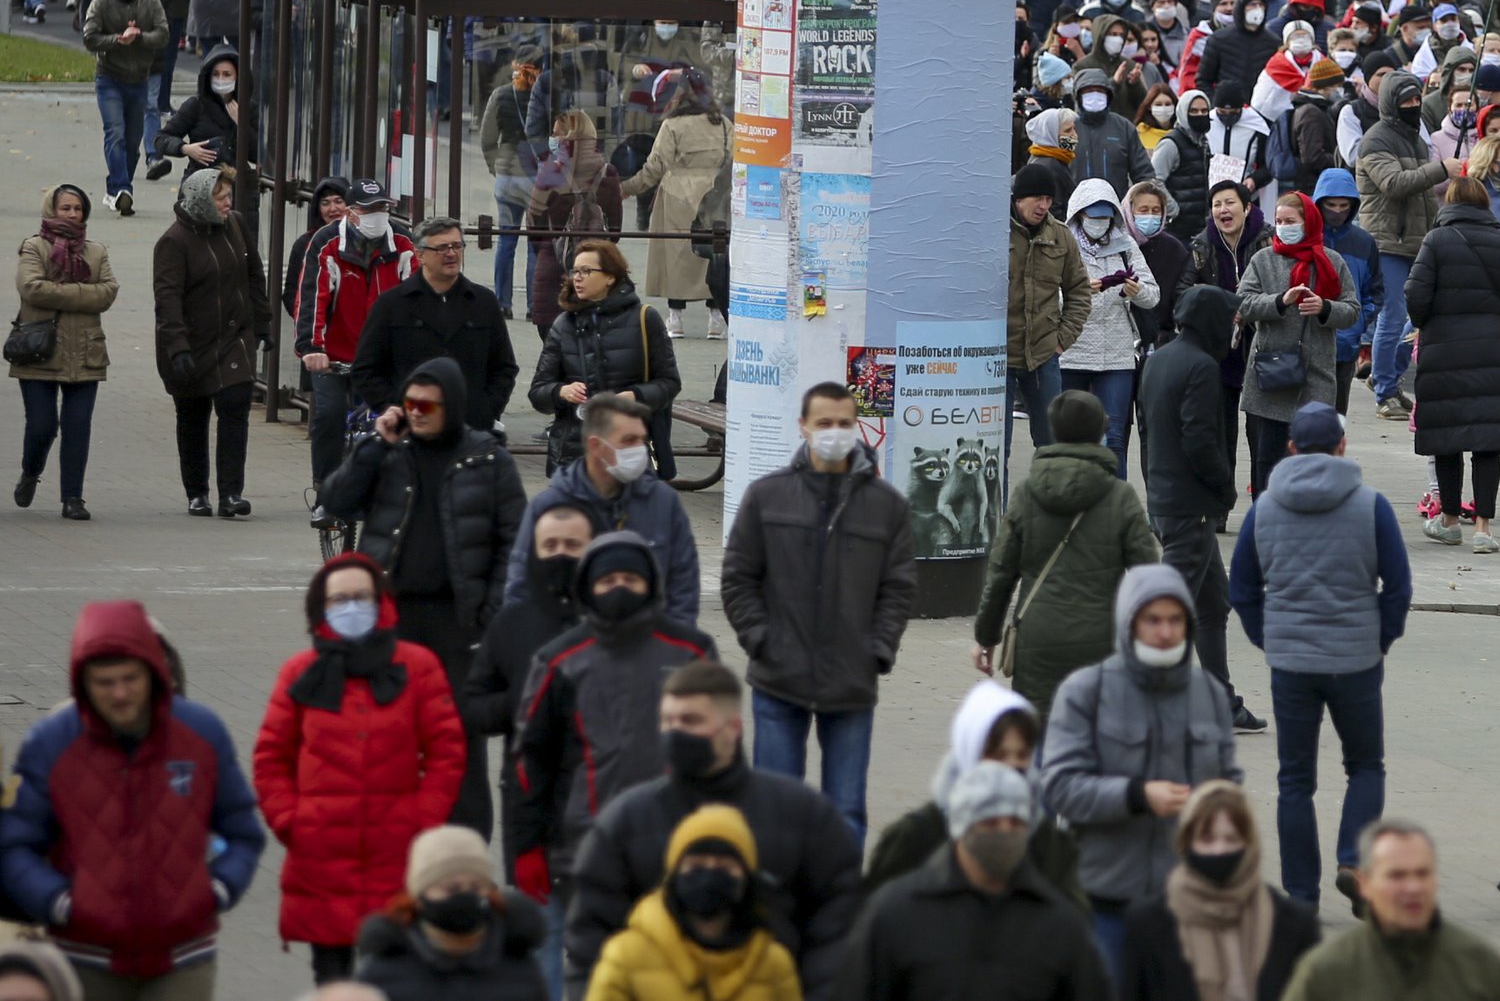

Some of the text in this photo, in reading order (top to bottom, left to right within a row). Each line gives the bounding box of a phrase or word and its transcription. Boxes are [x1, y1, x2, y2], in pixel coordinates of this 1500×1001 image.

[799, 29, 829, 43] WORLD
[813, 44, 873, 74] ROCK
[748, 125, 777, 137] ДОКТОР
[736, 339, 764, 362] ДЗЕНЬ
[899, 345, 952, 358] Позаботься
[953, 345, 962, 358] об
[729, 360, 780, 386] ЫШЫВАНКІ
[906, 363, 925, 375] уже
[927, 360, 958, 375] СЕЙЧАС
[900, 386, 924, 397] Сдай
[925, 388, 955, 397] старую
